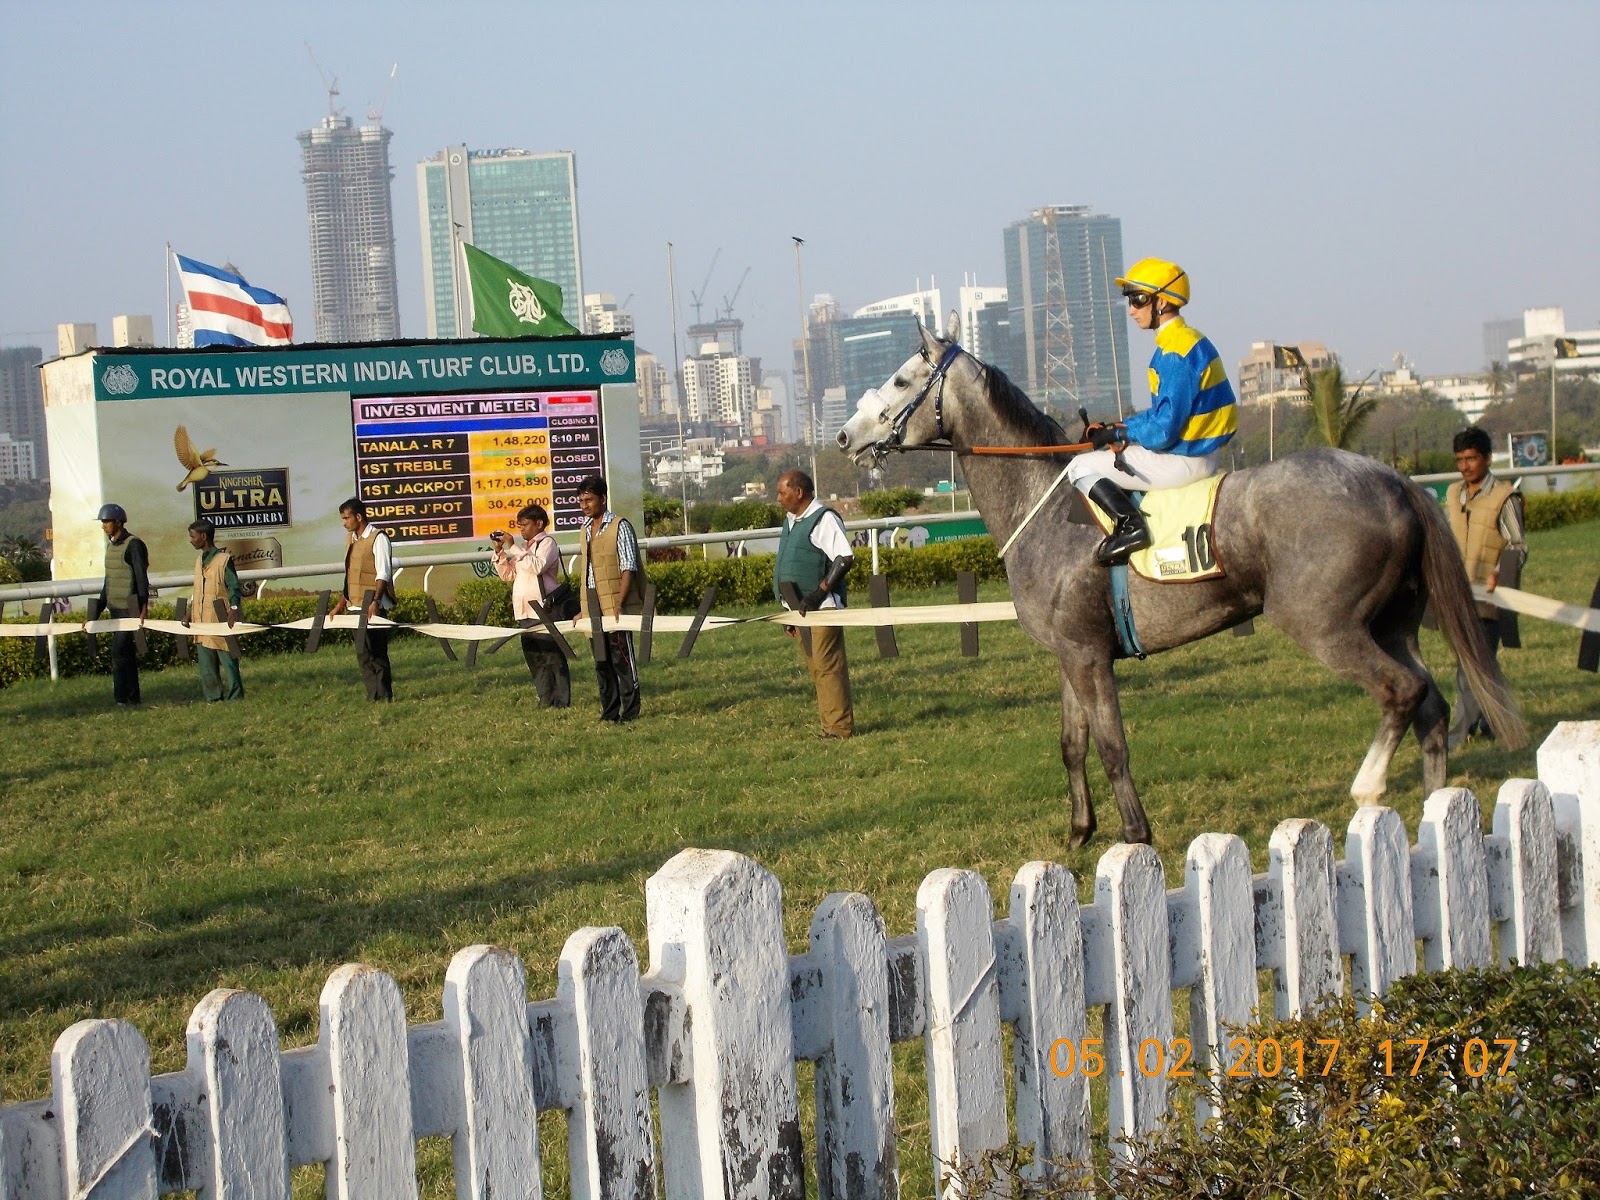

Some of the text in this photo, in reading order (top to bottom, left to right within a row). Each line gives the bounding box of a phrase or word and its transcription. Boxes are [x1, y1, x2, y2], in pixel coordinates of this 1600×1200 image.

[151, 353, 590, 390] ROYAL WESTERN INDIA TURF CLUB, LTD.
[364, 402, 475, 418] INVESTMENT
[479, 400, 537, 414] METER
[492, 435, 546, 447] 1,48,220
[551, 433, 590, 443] 5:10 PM
[360, 440, 419, 453] TANALA
[432, 439, 443, 450] R
[447, 439, 455, 449] 7
[505, 455, 547, 468] 35,940
[553, 454, 596, 463] CLOSED
[362, 460, 452, 475] 1ST TREBLE
[219, 475, 265, 490] KINGFISHER
[363, 481, 464, 496] 1ST JACKPOT
[475, 477, 548, 490] 1,17,05,890
[200, 488, 284, 510] ULTRA
[365, 505, 416, 518] SUPER
[202, 512, 284, 526] NDIAN DERBY
[400, 523, 458, 536] TREBLE
[1181, 523, 1216, 573] 10
